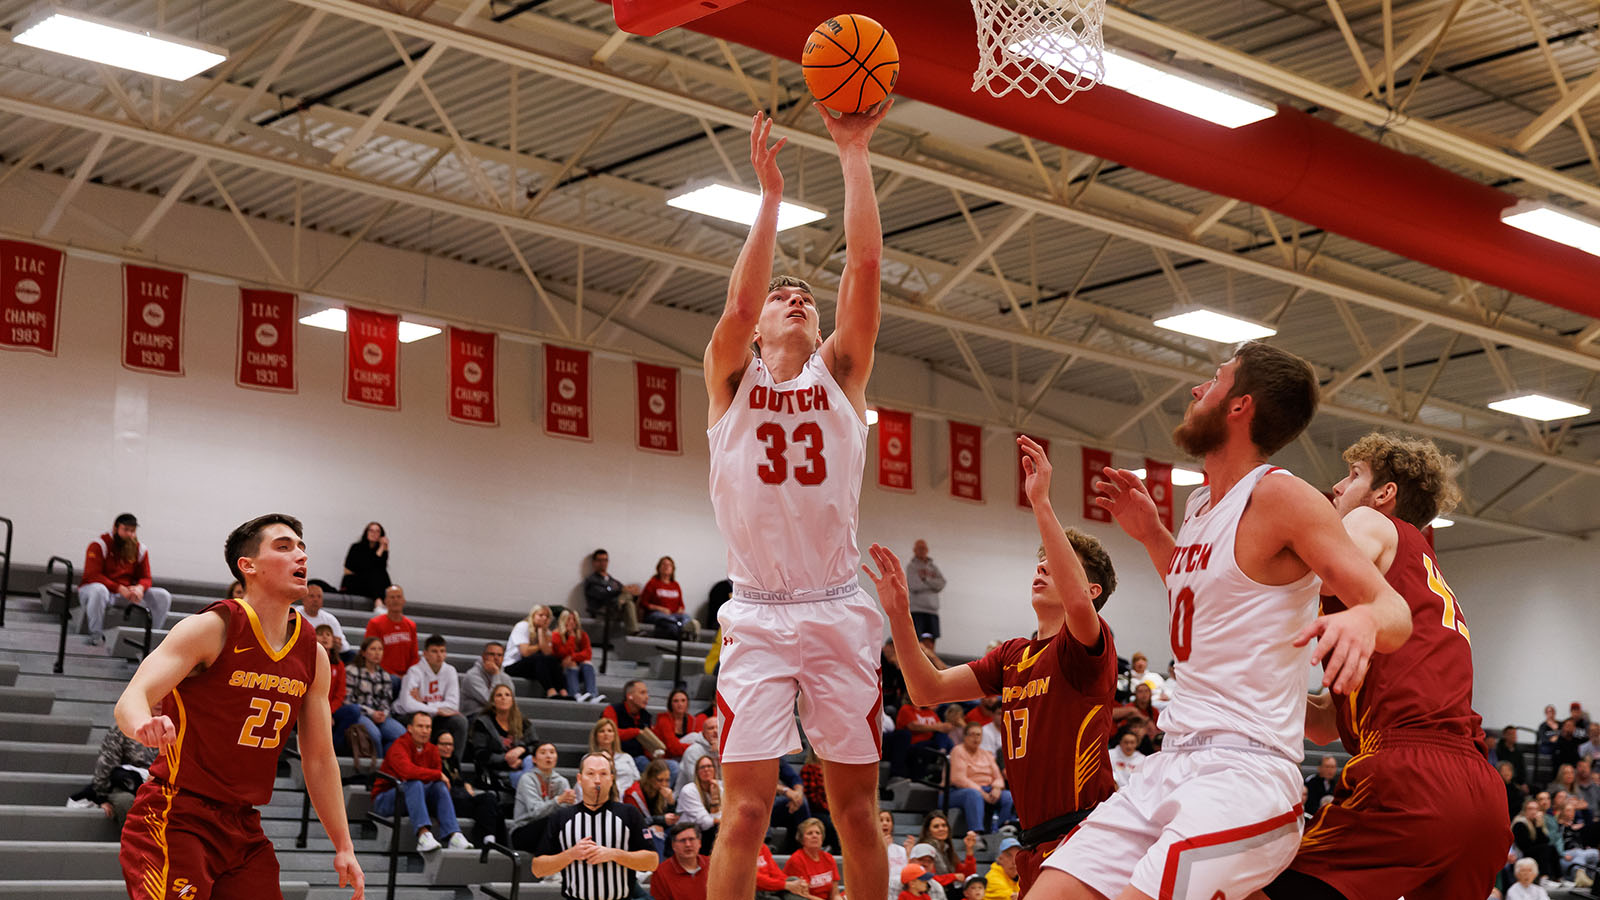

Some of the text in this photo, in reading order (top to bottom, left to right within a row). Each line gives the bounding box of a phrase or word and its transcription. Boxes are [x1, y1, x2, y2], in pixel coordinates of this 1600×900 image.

[14, 255, 46, 275] IIAC
[140, 281, 169, 299] IIAC
[4, 308, 47, 328] CHAMPS
[251, 302, 280, 319] IIAC
[360, 321, 387, 339] IIAC
[132, 331, 174, 350] CHAMPS
[460, 341, 485, 358] IIAC
[141, 350, 165, 366] 1930
[247, 351, 288, 368] CHAMPS
[555, 359, 579, 374] IIAC
[256, 369, 278, 383] 1931
[353, 368, 391, 387] CHAMPS
[455, 386, 490, 404] CHAMPS
[749, 385, 830, 414] DUTCH
[550, 402, 583, 419] CHAMPS
[642, 418, 673, 433] CHAMPS
[756, 421, 827, 487] 33
[743, 590, 794, 601] UNDER
[228, 670, 308, 698] SIMPSON
[428, 680, 439, 694] C
[237, 697, 291, 749] 23
[1003, 707, 1029, 760] 13
